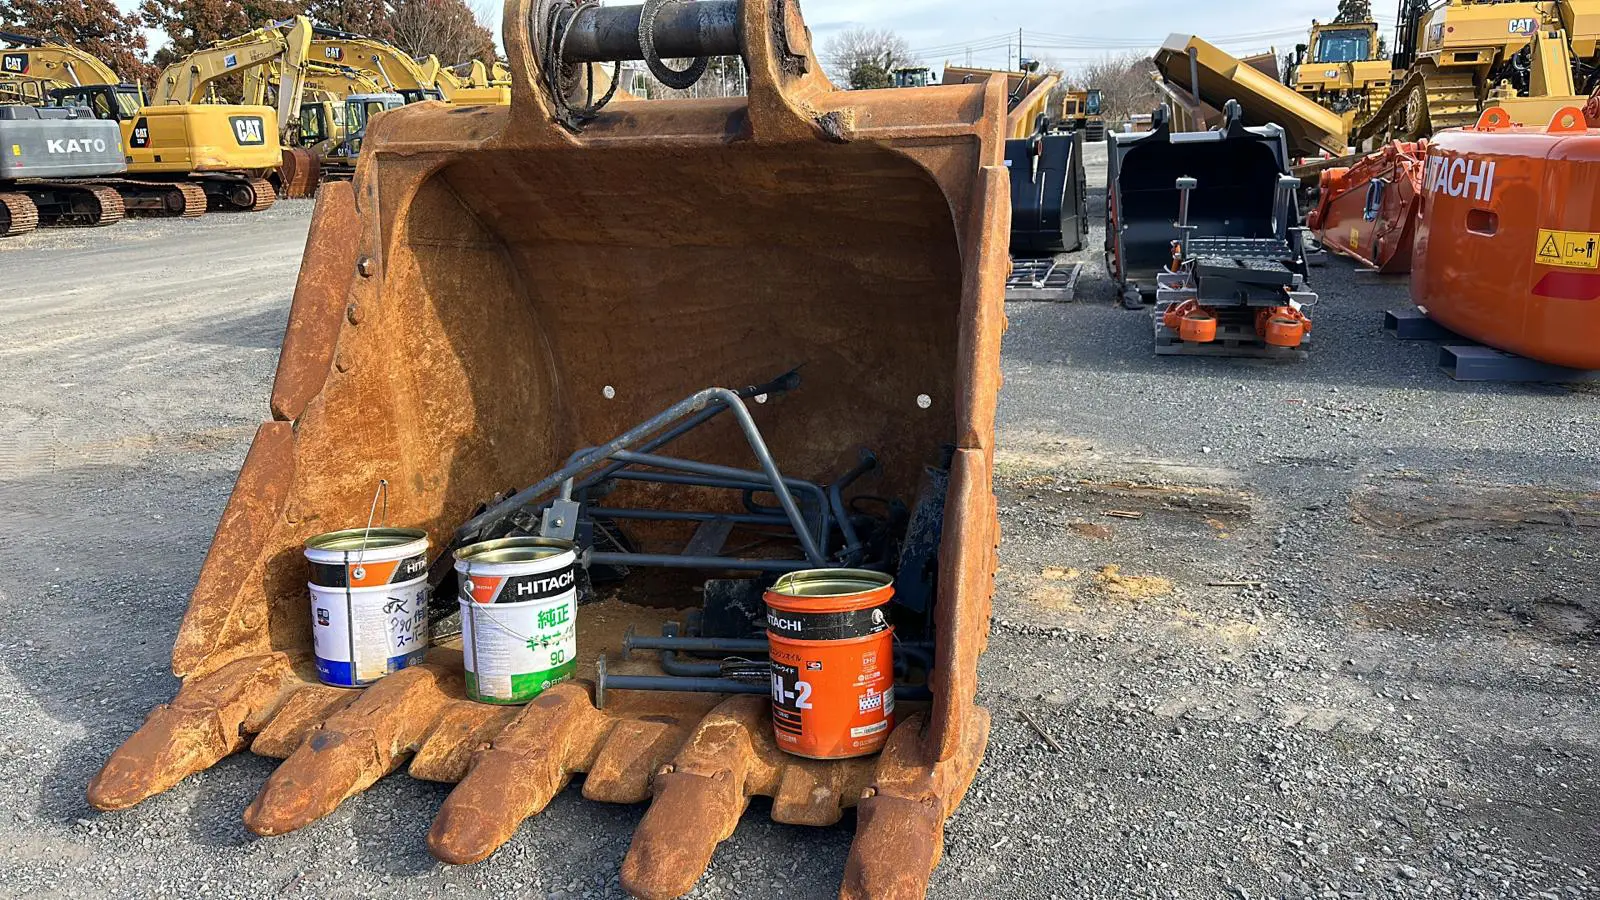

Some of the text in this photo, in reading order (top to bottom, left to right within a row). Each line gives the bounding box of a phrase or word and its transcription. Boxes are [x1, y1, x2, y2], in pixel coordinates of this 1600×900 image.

[1508, 19, 1532, 32] CAT
[326, 47, 340, 59] CAT
[5, 56, 22, 71] CAT
[135, 127, 147, 138] CAT
[236, 119, 262, 142] CAT
[47, 138, 106, 154] KATO
[1424, 155, 1496, 201] HITACHI
[517, 568, 574, 595] HITACH
[537, 603, 569, 629] 純正
[767, 613, 802, 631] ITACHI
[550, 649, 565, 666] 90
[773, 672, 813, 710] H-2
